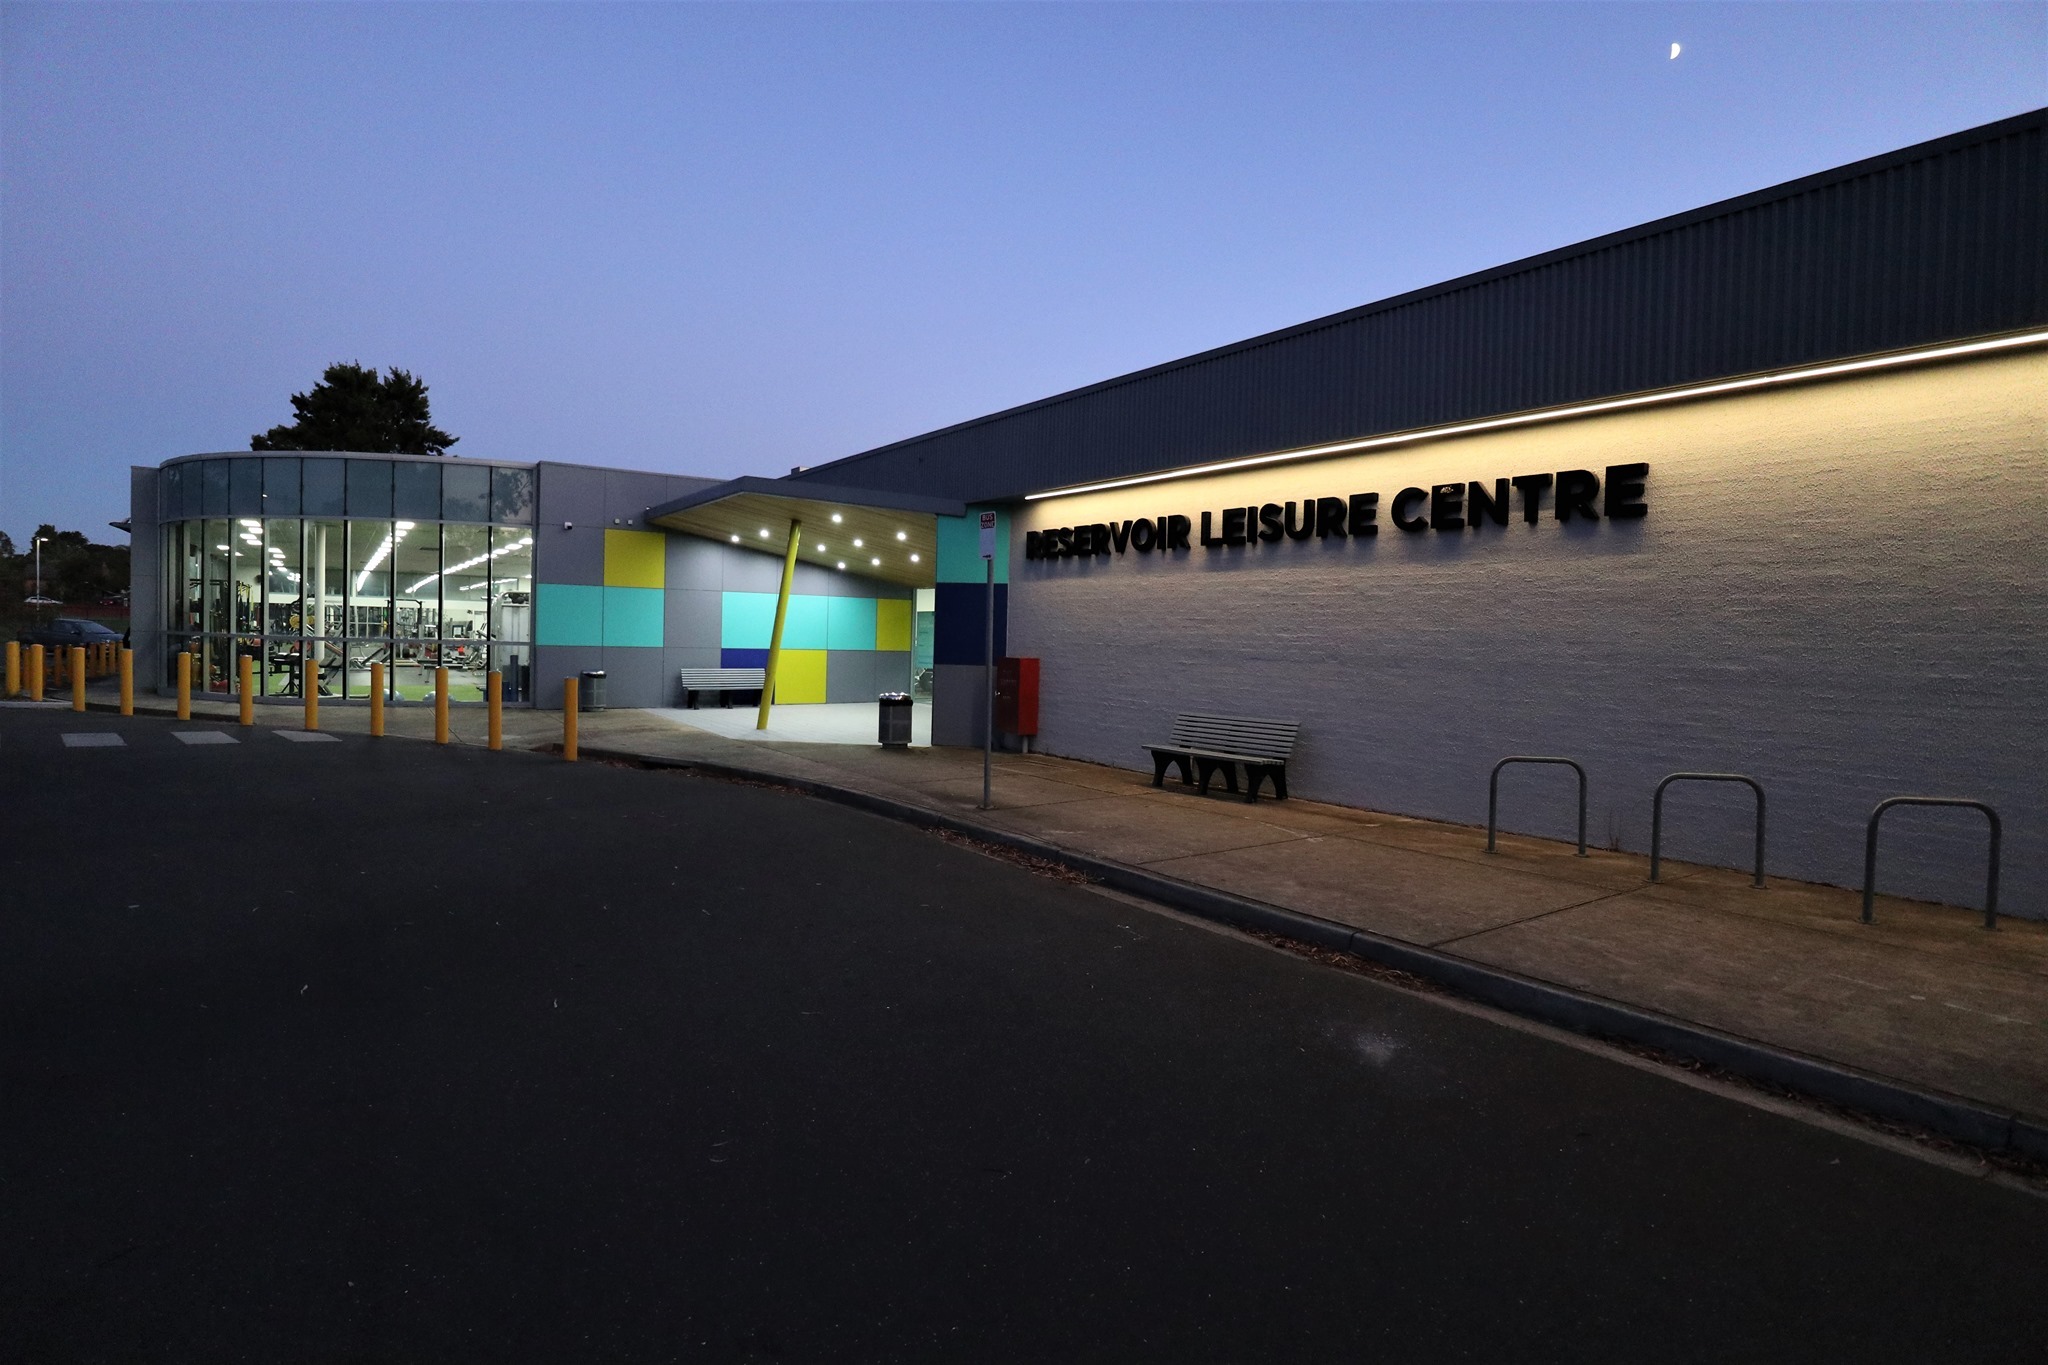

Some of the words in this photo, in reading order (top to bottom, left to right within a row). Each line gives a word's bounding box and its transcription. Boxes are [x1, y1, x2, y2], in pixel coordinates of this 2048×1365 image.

[1026, 514, 1191, 560] RESERVOIR
[1201, 492, 1379, 546] LEISURE
[1391, 463, 1649, 532] CENTRE
[982, 513, 993, 521] BUS
[981, 520, 994, 528] ZONE
